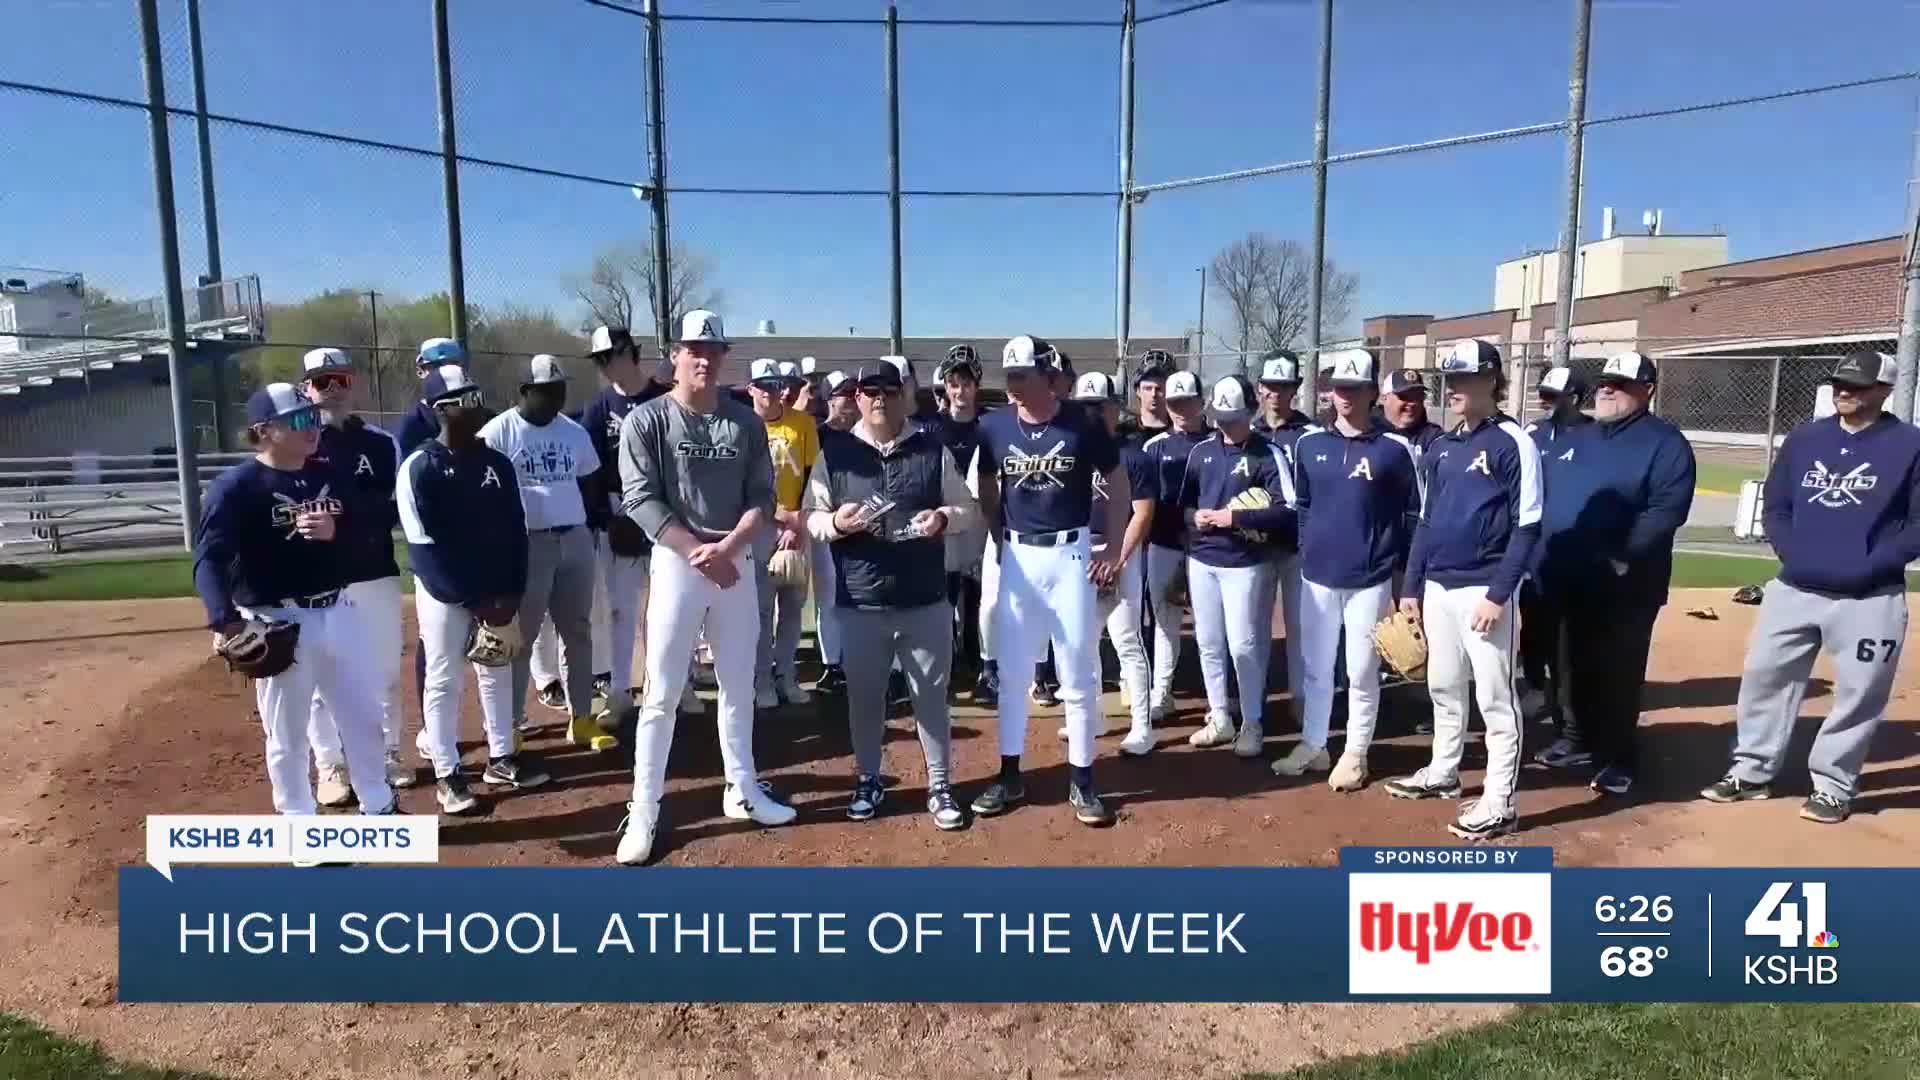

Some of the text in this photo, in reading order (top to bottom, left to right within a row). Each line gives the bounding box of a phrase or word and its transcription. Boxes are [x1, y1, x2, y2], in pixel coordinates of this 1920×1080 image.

[699, 318, 716, 337] A
[1006, 348, 1019, 363] A
[1608, 358, 1621, 371] A
[1273, 364, 1285, 377] A
[1345, 359, 1359, 375] A
[1174, 381, 1185, 392] A
[1218, 394, 1232, 408] A
[675, 441, 738, 459] Saints
[1558, 447, 1575, 461] A
[354, 454, 375, 477] A
[1003, 455, 1075, 475] Saints
[1230, 456, 1250, 477] A
[1348, 457, 1373, 480] A
[1465, 450, 1490, 475] A
[480, 466, 502, 488] A
[1856, 638, 1897, 663] 67
